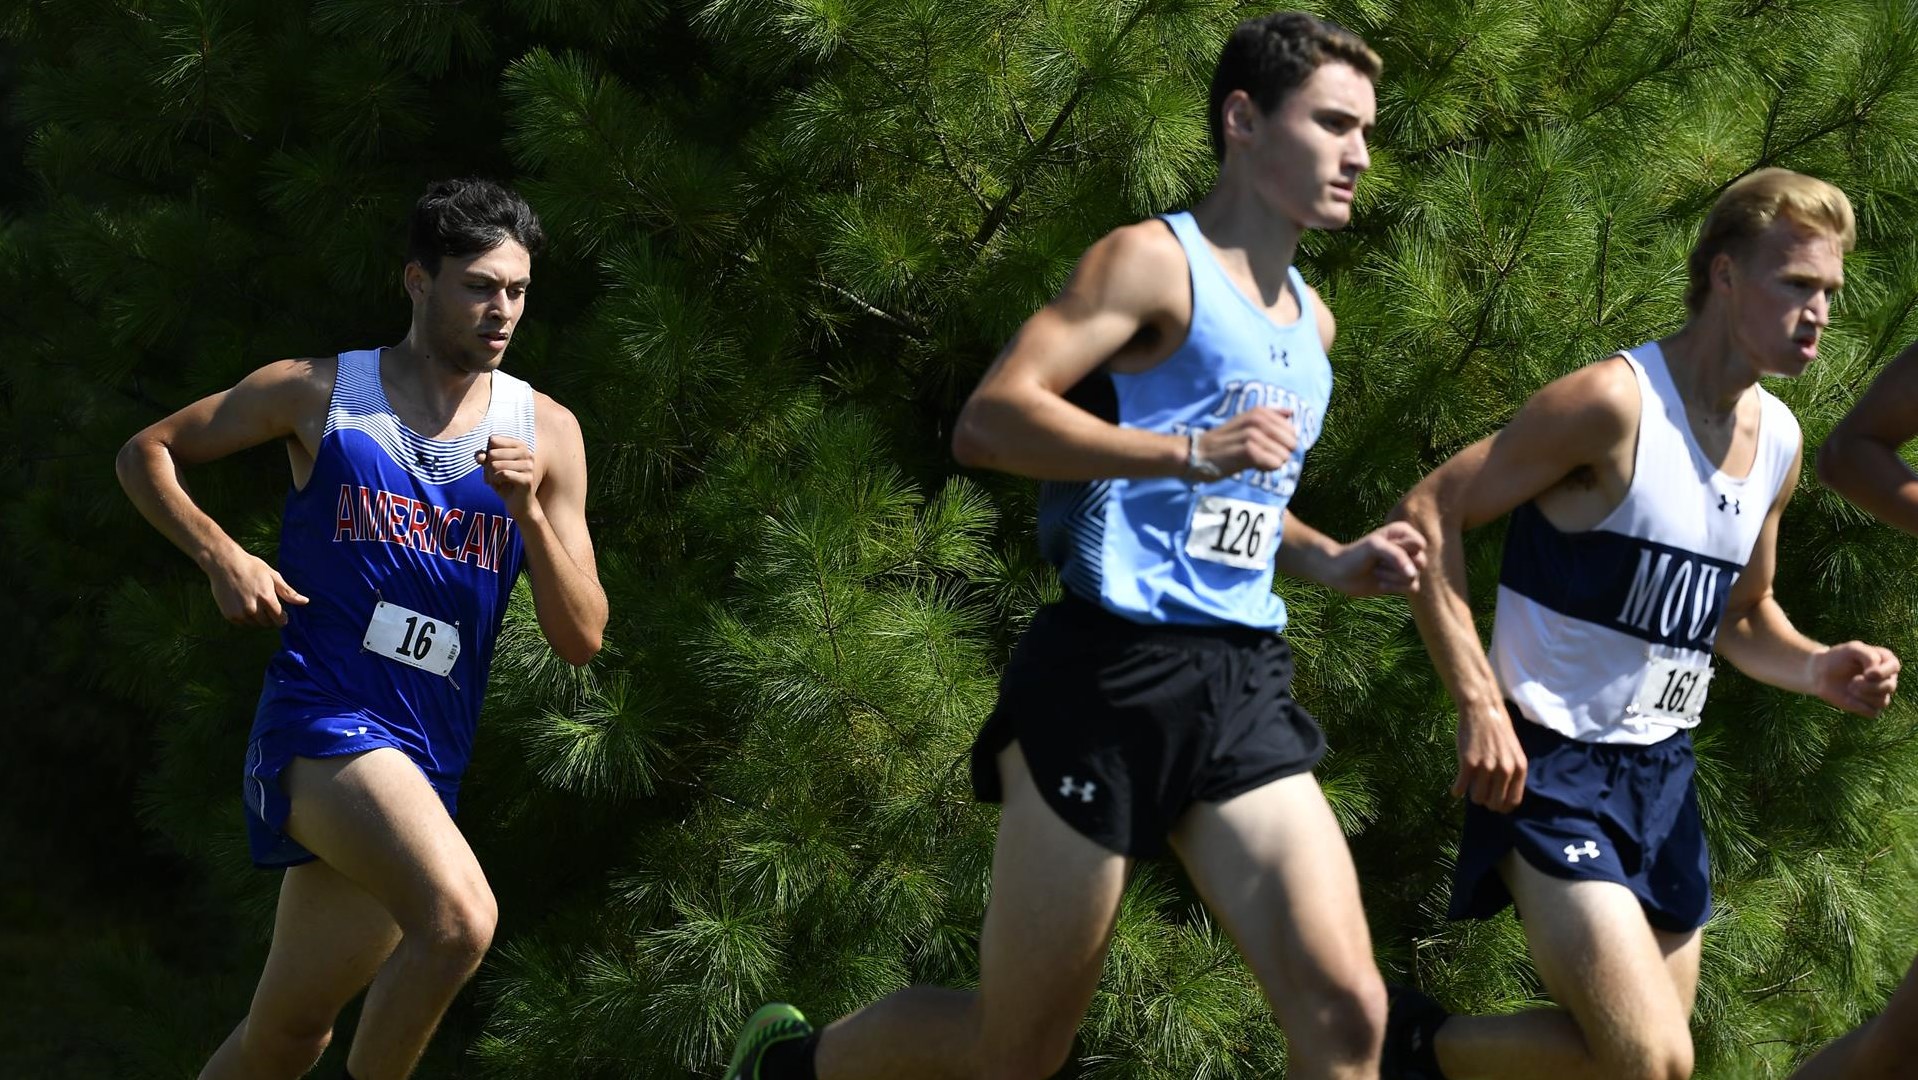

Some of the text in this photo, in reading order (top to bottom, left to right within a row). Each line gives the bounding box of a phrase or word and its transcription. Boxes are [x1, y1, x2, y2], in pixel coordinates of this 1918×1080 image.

[333, 484, 513, 573] AMERICAN
[1210, 507, 1264, 558] 126
[1616, 549, 1740, 645] MOU
[395, 616, 436, 661] 16
[1654, 669, 1699, 713] 161
